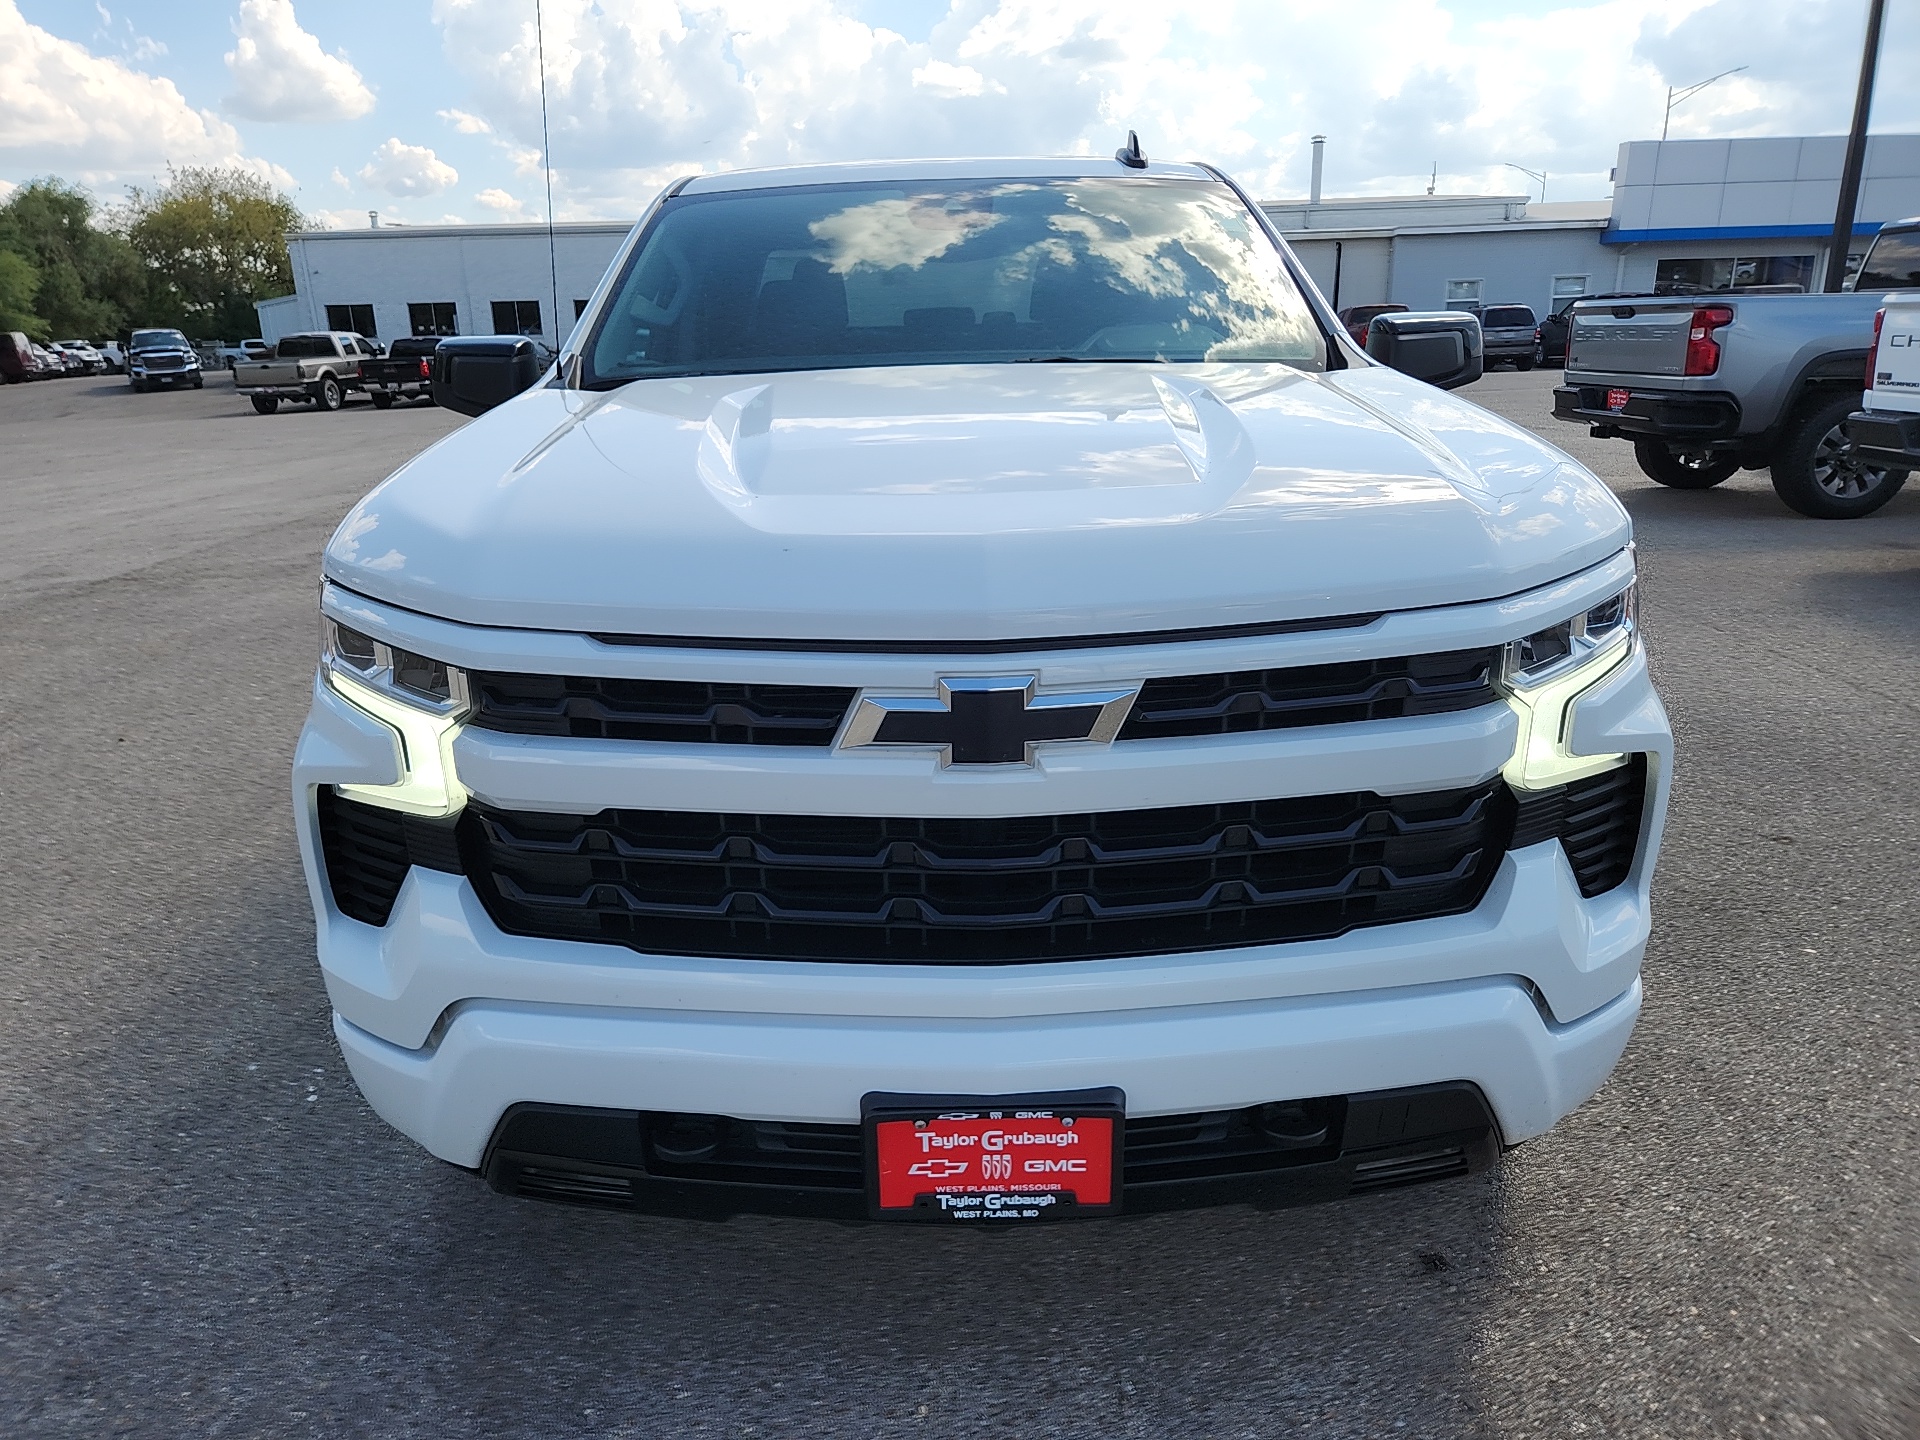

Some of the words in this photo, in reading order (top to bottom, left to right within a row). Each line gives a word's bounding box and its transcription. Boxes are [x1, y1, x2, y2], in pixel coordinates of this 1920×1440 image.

[1574, 328, 1679, 342] CHEVROLET
[1015, 1111, 1053, 1119] GMC
[914, 1131, 979, 1153] Taylor
[980, 1130, 1079, 1151] Grubaugh
[1023, 1159, 1087, 1173] GMC
[935, 1185, 964, 1193] WEST
[966, 1184, 1009, 1192] PLAINS,
[1010, 1183, 1062, 1191] MISSOURI
[935, 1194, 983, 1210] Taylor
[984, 1193, 1057, 1209] Grubaugh
[953, 1210, 981, 1218] WEST
[983, 1209, 1021, 1218] PLAINS,
[1022, 1209, 1040, 1217] MO
